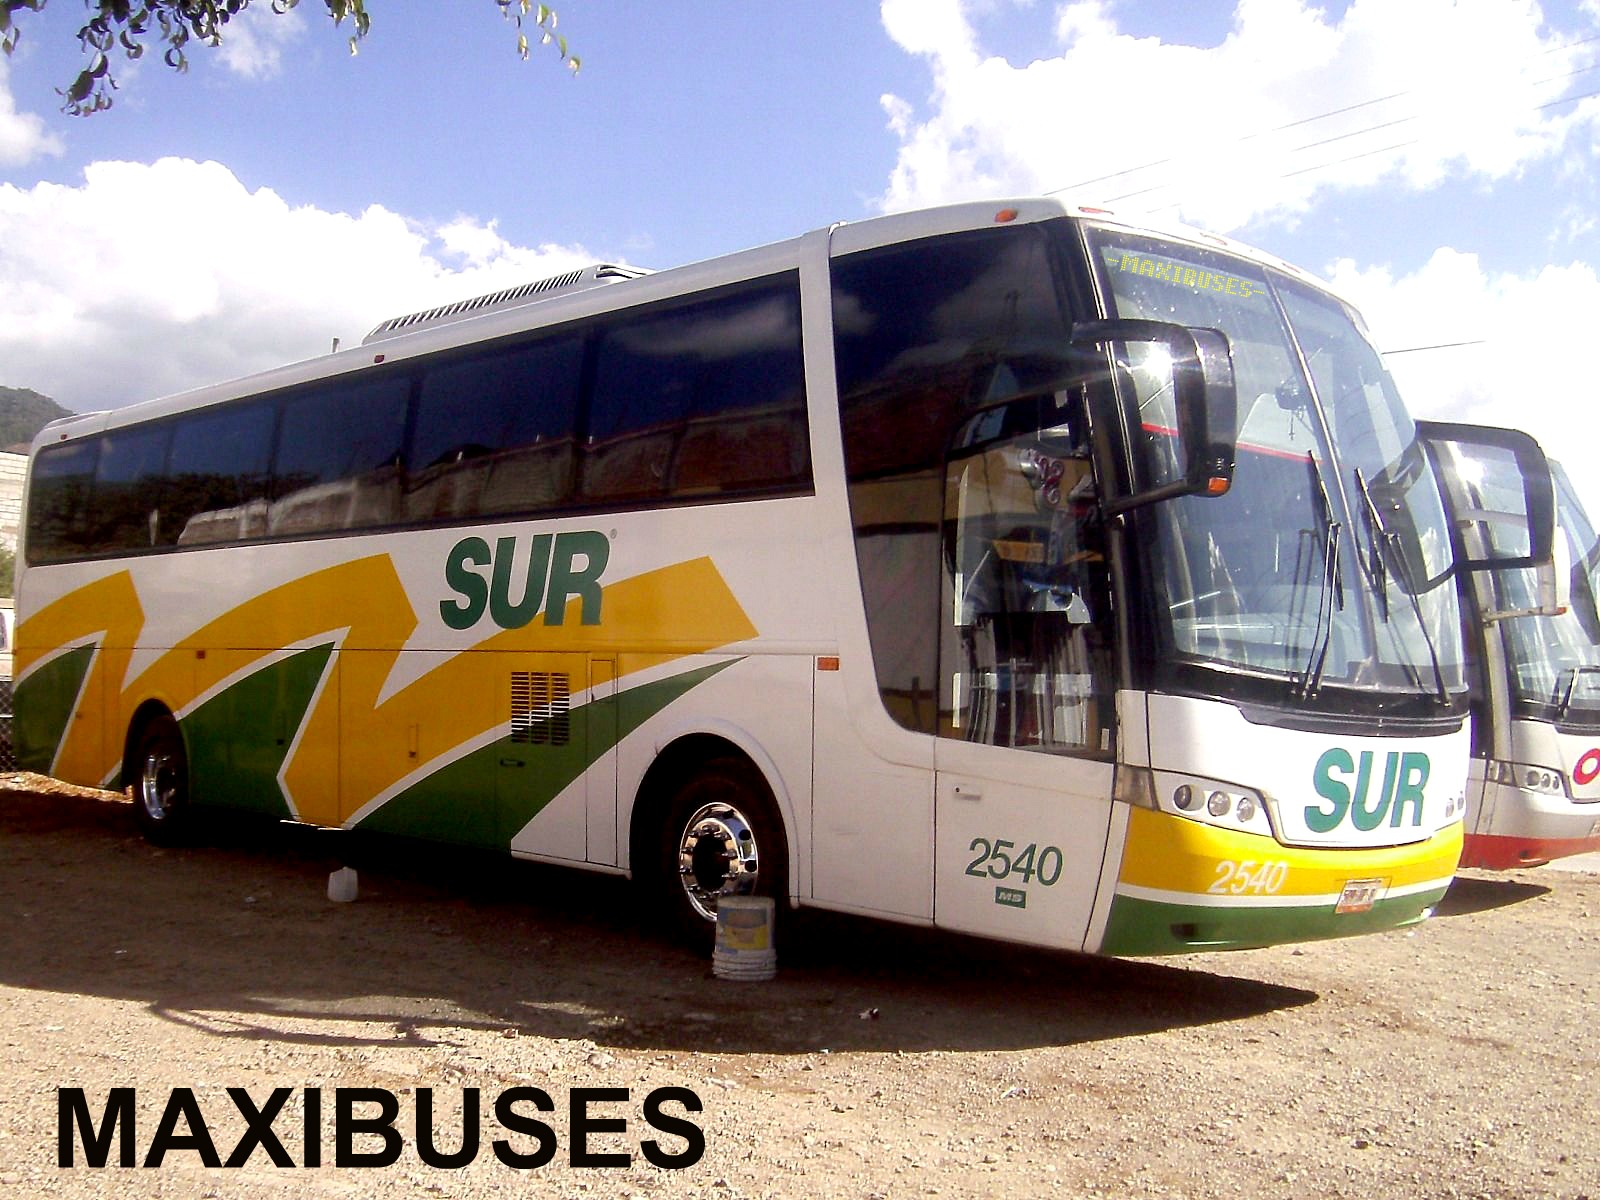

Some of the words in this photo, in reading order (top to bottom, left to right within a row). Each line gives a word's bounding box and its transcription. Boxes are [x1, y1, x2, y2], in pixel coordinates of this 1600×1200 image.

[439, 530, 610, 630] SUR
[1304, 747, 1430, 833] SUR
[965, 837, 1063, 886] 2540
[1207, 860, 1288, 894] 2540
